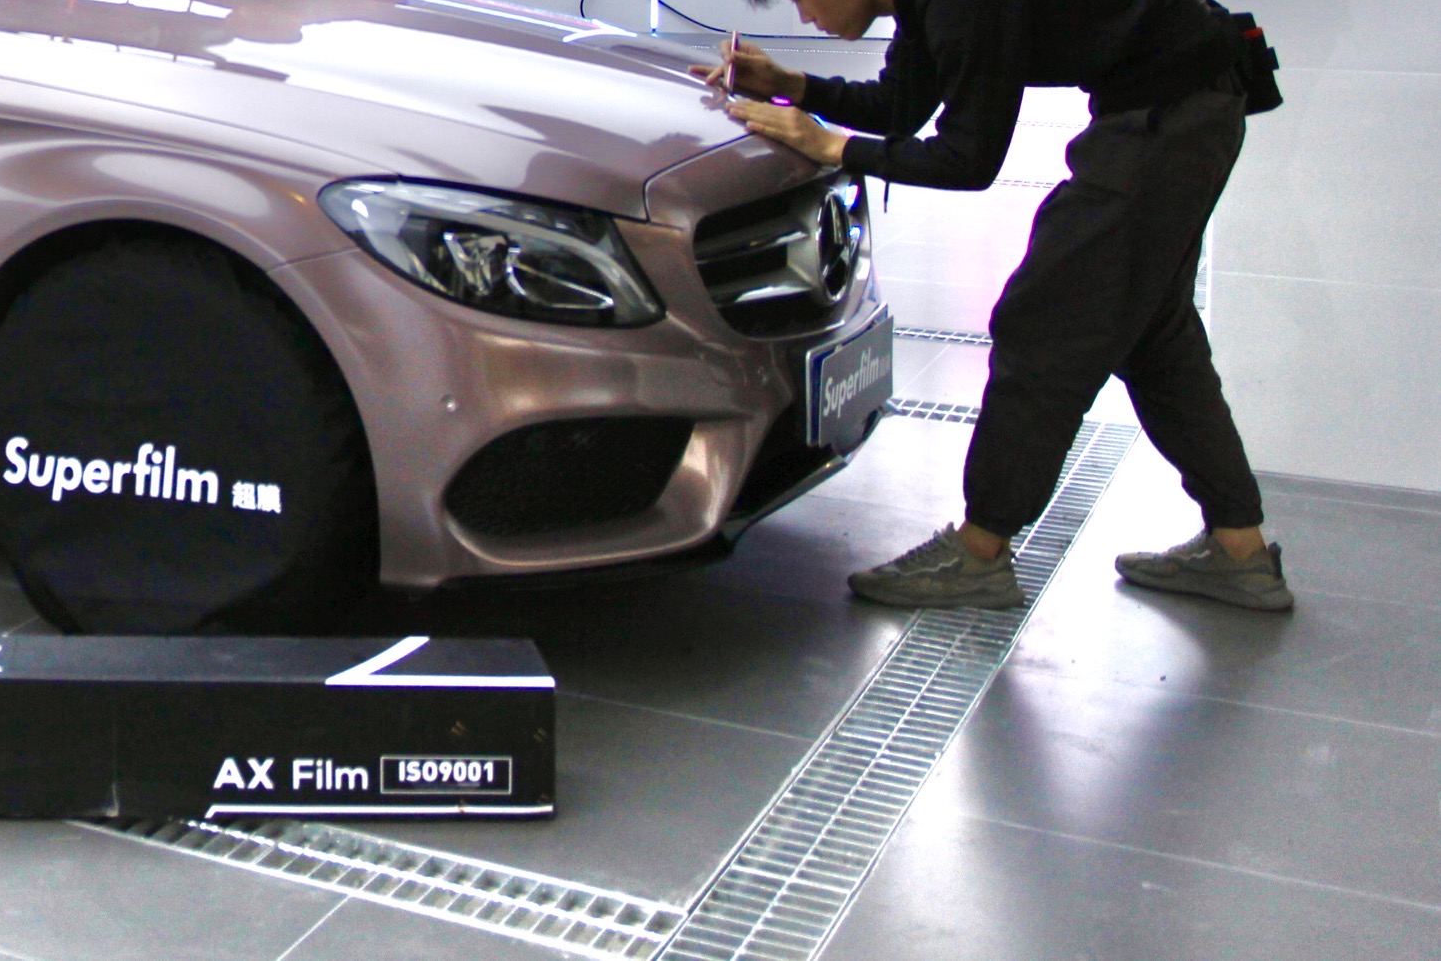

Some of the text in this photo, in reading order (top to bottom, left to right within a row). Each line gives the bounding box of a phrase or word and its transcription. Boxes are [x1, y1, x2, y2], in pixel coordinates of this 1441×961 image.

[823, 347, 879, 419] Superfilm
[3, 436, 219, 504] Superfilm
[213, 757, 495, 790] AX Film ISO9001
